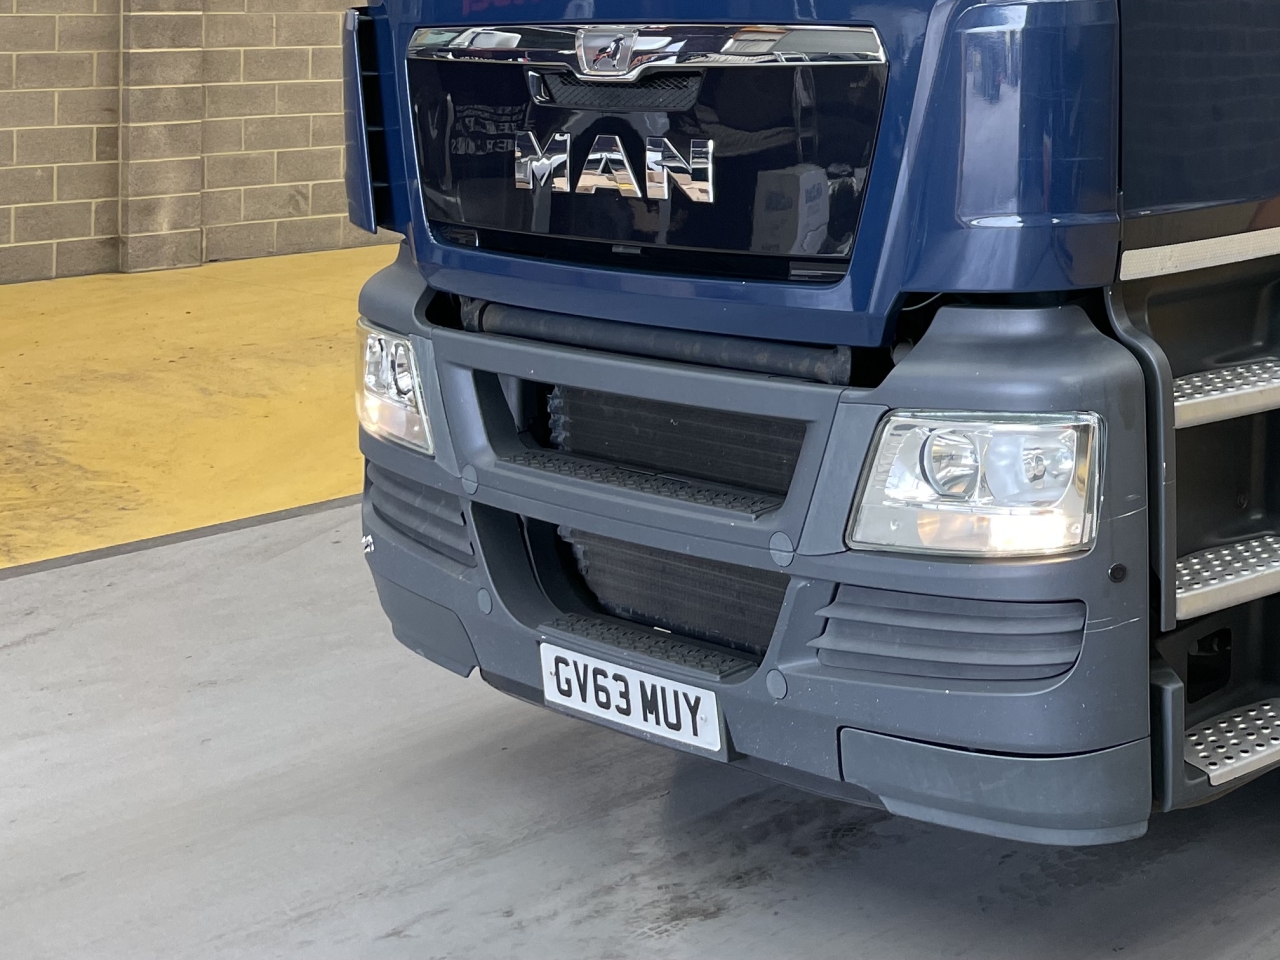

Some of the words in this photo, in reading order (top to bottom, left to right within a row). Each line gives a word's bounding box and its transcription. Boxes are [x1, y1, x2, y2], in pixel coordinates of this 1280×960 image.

[515, 130, 714, 204] MAN
[554, 655, 632, 717] GV63
[639, 680, 702, 737] MUY
